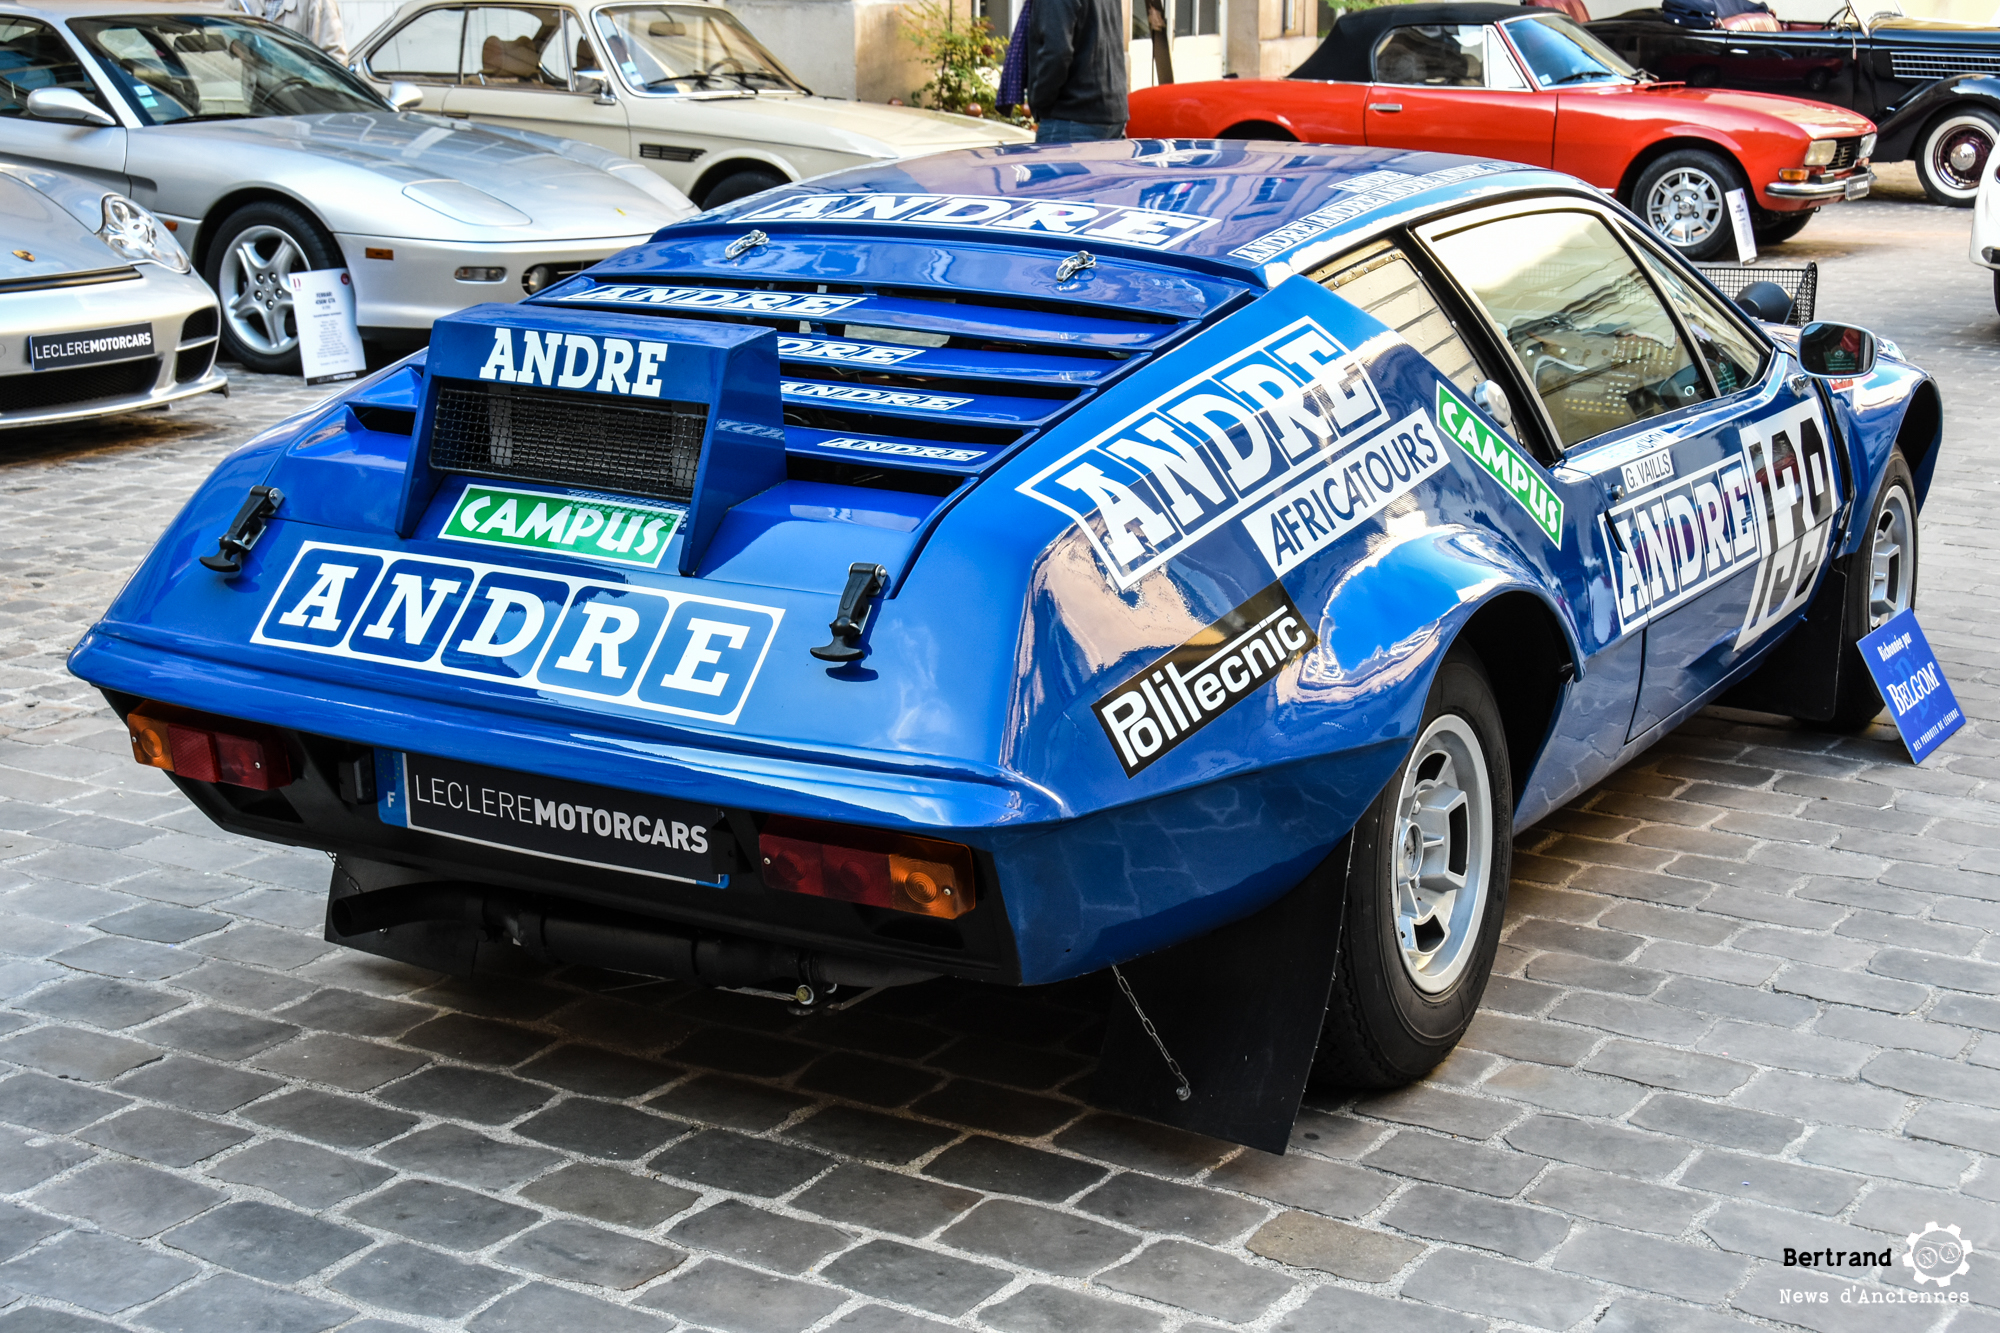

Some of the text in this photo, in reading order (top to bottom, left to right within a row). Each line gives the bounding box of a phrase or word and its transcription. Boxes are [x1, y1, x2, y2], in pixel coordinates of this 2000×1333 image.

[757, 195, 1196, 244] ANDRE
[1240, 221, 1322, 261] ANDRE
[1314, 194, 1377, 228] ANDRE
[582, 286, 852, 315] ANDRE
[35, 332, 151, 360] LECLEREMOTORCARS
[479, 328, 667, 398] ANDRE
[778, 339, 912, 362] DRE
[833, 438, 981, 460] ANDRE
[1055, 329, 1377, 566] ANDRE
[1442, 401, 1558, 533] CAMPUS
[1625, 453, 1671, 488] G. VAILLS
[1270, 422, 1438, 566] AFRICATOURS
[459, 495, 668, 556] CAMPUS
[1615, 466, 1756, 618] ANDRE
[278, 562, 750, 697] ANDRE
[1901, 631, 1912, 650] par
[1920, 724, 1939, 746] PRODUITS
[1937, 720, 1945, 731] DE
[1942, 708, 1960, 727] LÉGENDE
[387, 791, 395, 808] F
[415, 774, 708, 854] LECLEREMOTORCARS
